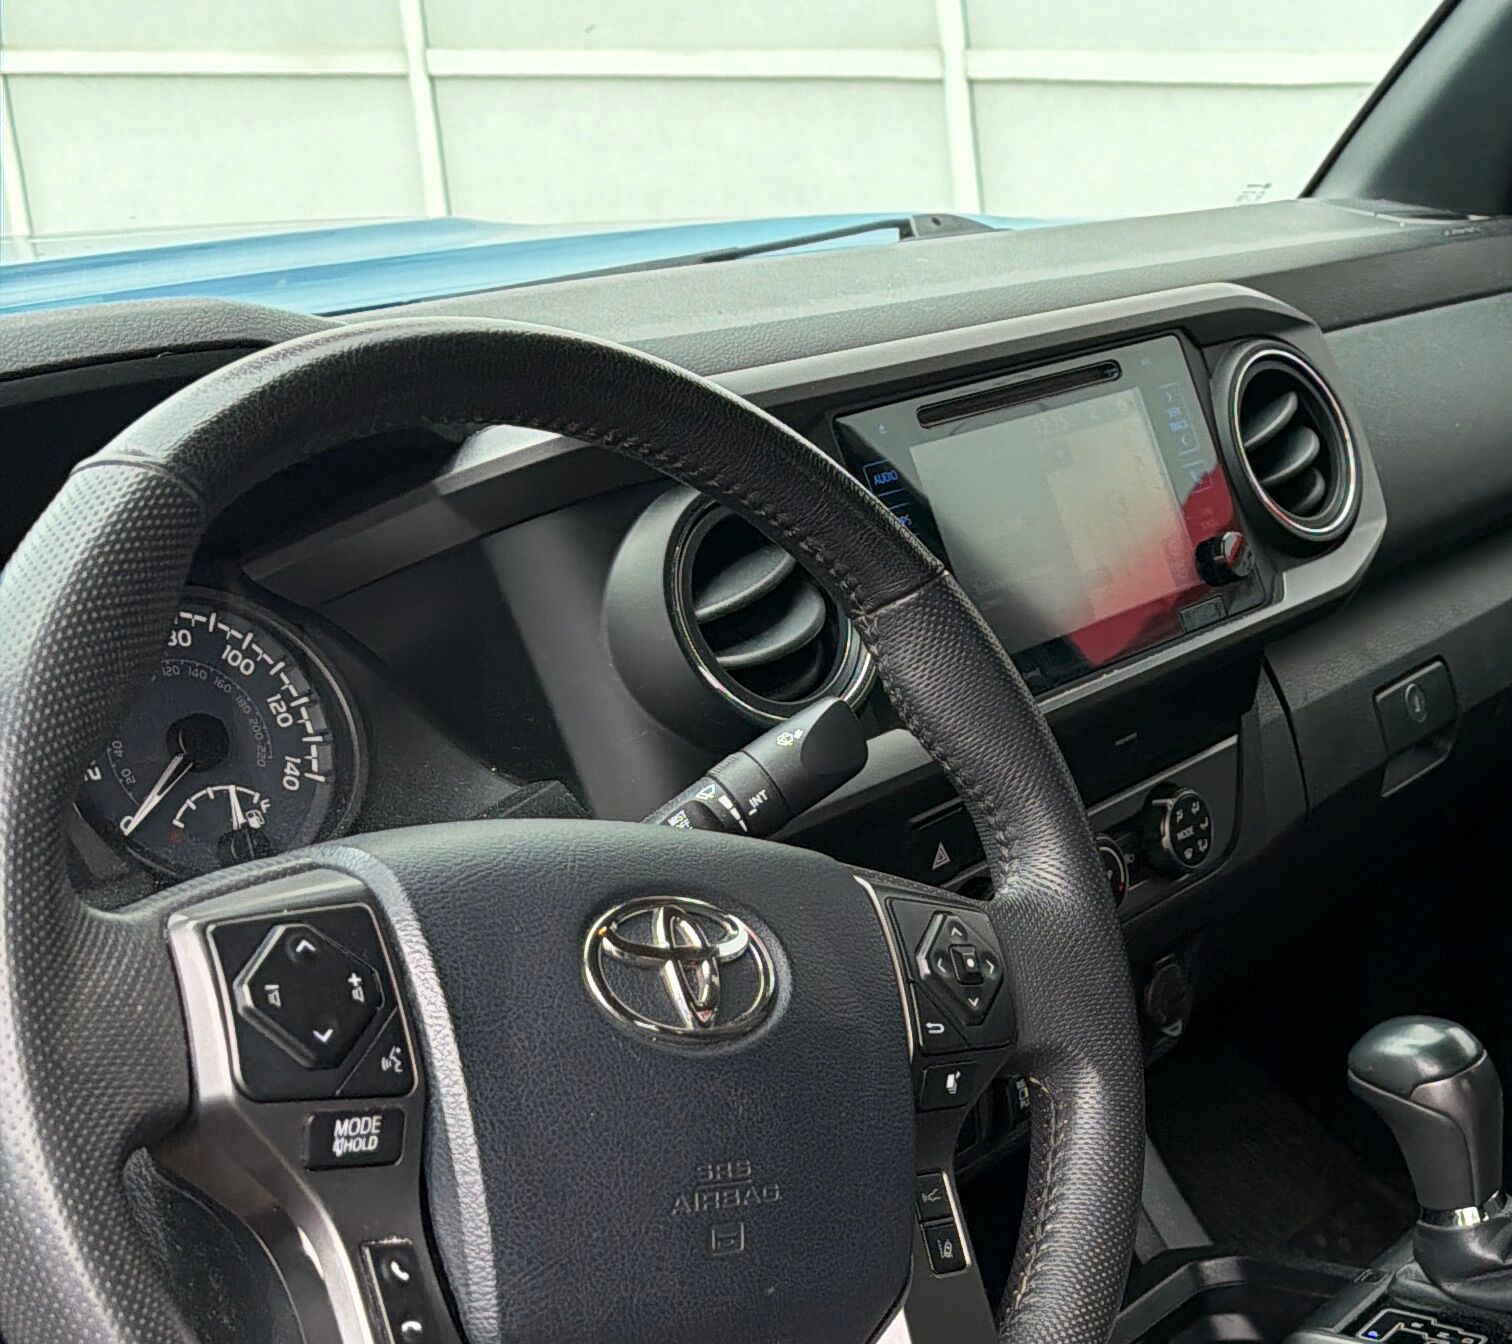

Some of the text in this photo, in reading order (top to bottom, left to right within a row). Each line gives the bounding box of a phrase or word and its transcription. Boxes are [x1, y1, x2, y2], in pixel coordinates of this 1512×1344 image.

[873, 470, 898, 485] AUDIO
[221, 644, 255, 676] 100
[161, 665, 181, 677] 120
[187, 667, 208, 680] 140
[213, 676, 233, 694] 160
[266, 693, 293, 728] 120
[111, 740, 124, 758] 40
[121, 768, 137, 785] 20
[282, 756, 302, 791] 140
[749, 789, 768, 808] INT
[668, 810, 687, 826] MIST
[1176, 825, 1195, 841] MODE
[333, 1114, 383, 1137] MODE
[343, 1136, 378, 1153] HOLD
[695, 1158, 753, 1180] SRS
[670, 1183, 783, 1217] AIRBAG
